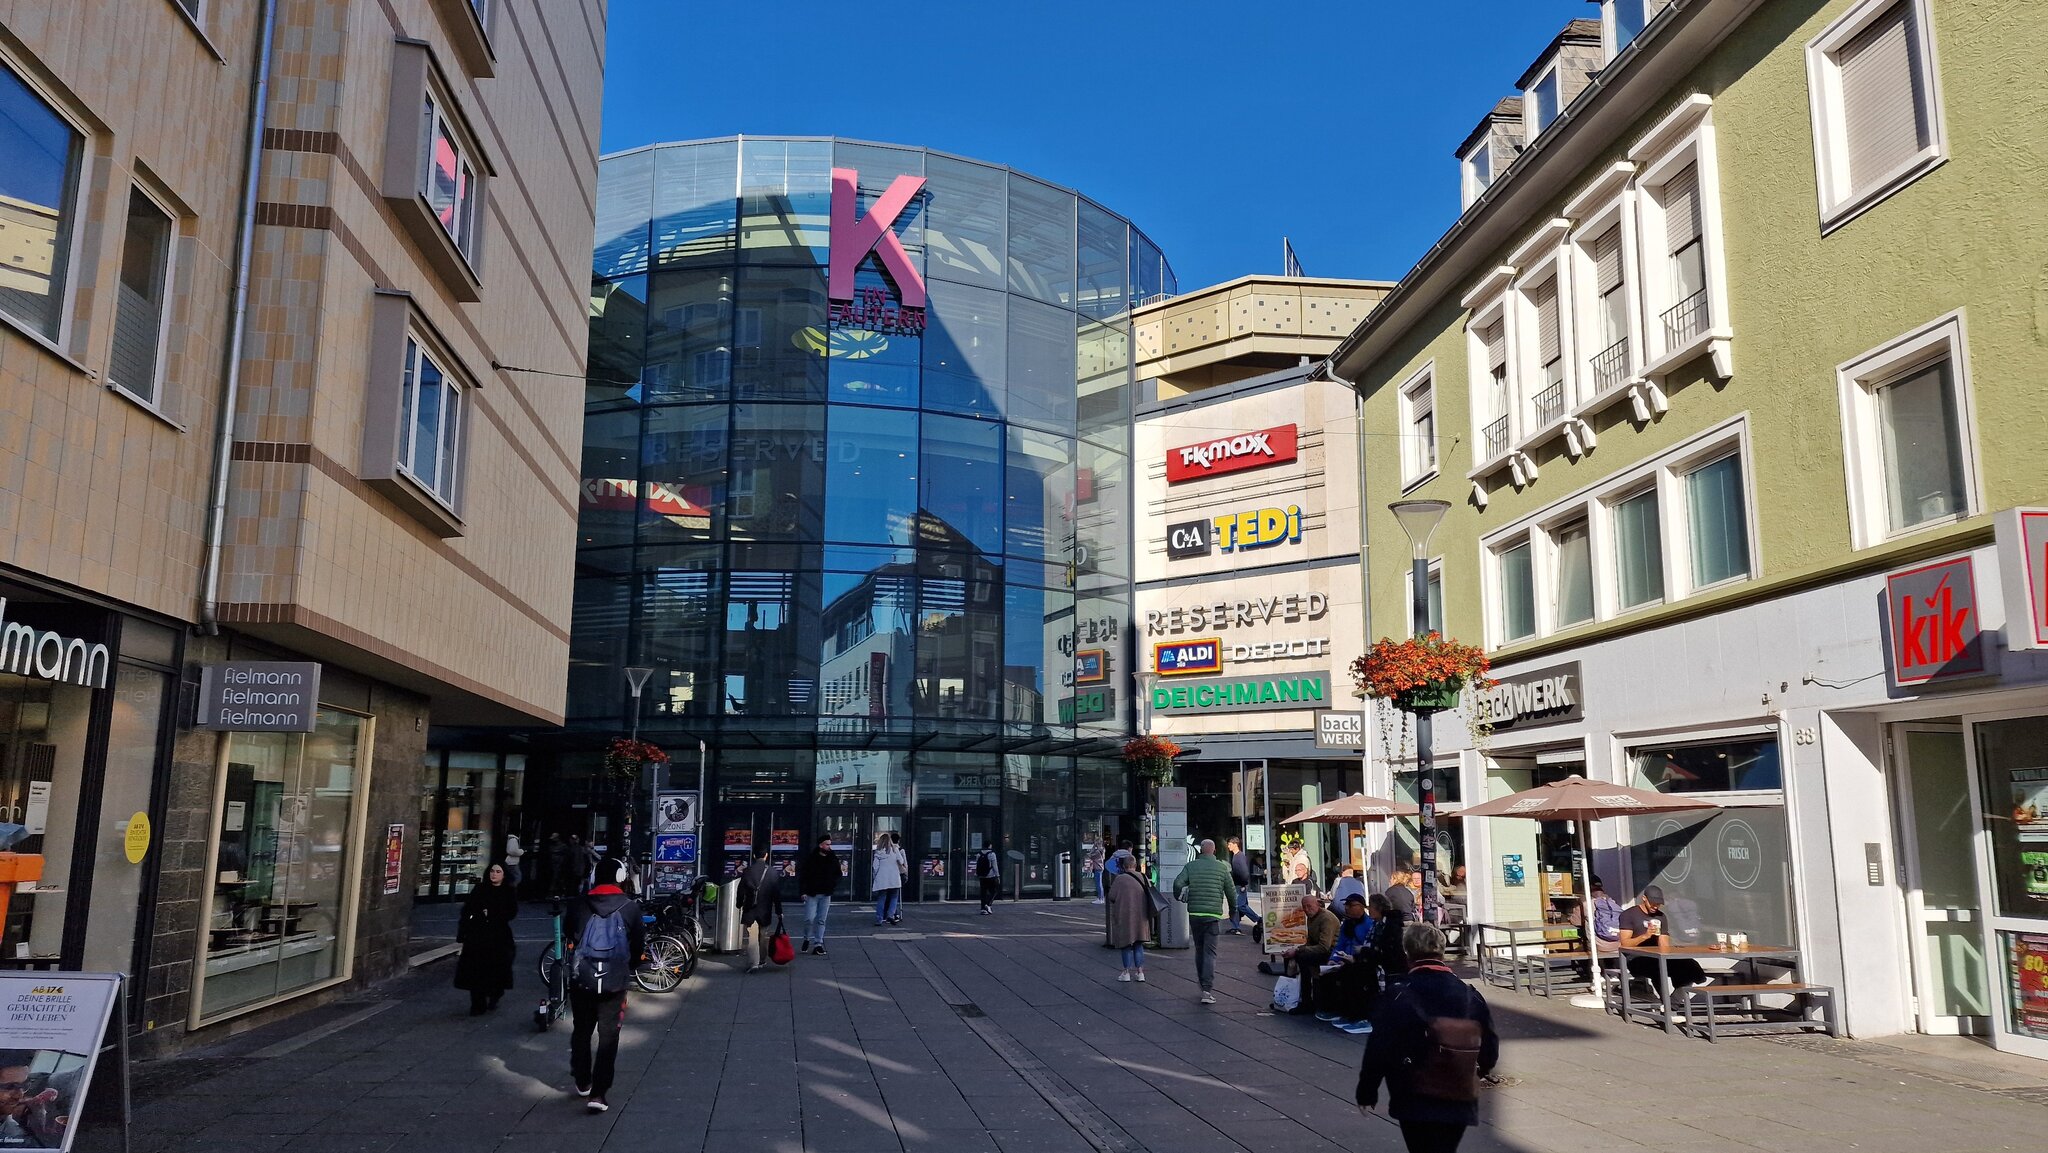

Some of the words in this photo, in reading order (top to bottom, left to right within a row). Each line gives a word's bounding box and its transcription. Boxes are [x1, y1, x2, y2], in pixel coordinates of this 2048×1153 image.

[828, 168, 927, 307] K
[864, 287, 886, 304] IN
[828, 304, 927, 329] LAUTERN
[1214, 504, 1301, 549] TEDi
[1171, 526, 1204, 549] C&A
[1145, 592, 1328, 632] RESERVED
[1177, 646, 1213, 661] ALDI
[1232, 637, 1328, 661] DEPOT
[1153, 678, 1323, 709] DEICHMANN
[1323, 716, 1359, 730] back
[1321, 733, 1362, 745] WERK
[1727, 847, 1750, 860] FRISCH
[18, 994, 44, 1002] DEINE
[45, 995, 72, 1003] BRILLE
[7, 1003, 57, 1012] GEMACHT
[58, 1003, 77, 1013] FÜR
[10, 1013, 35, 1021] DEIN
[36, 1013, 68, 1021] LEBEN
